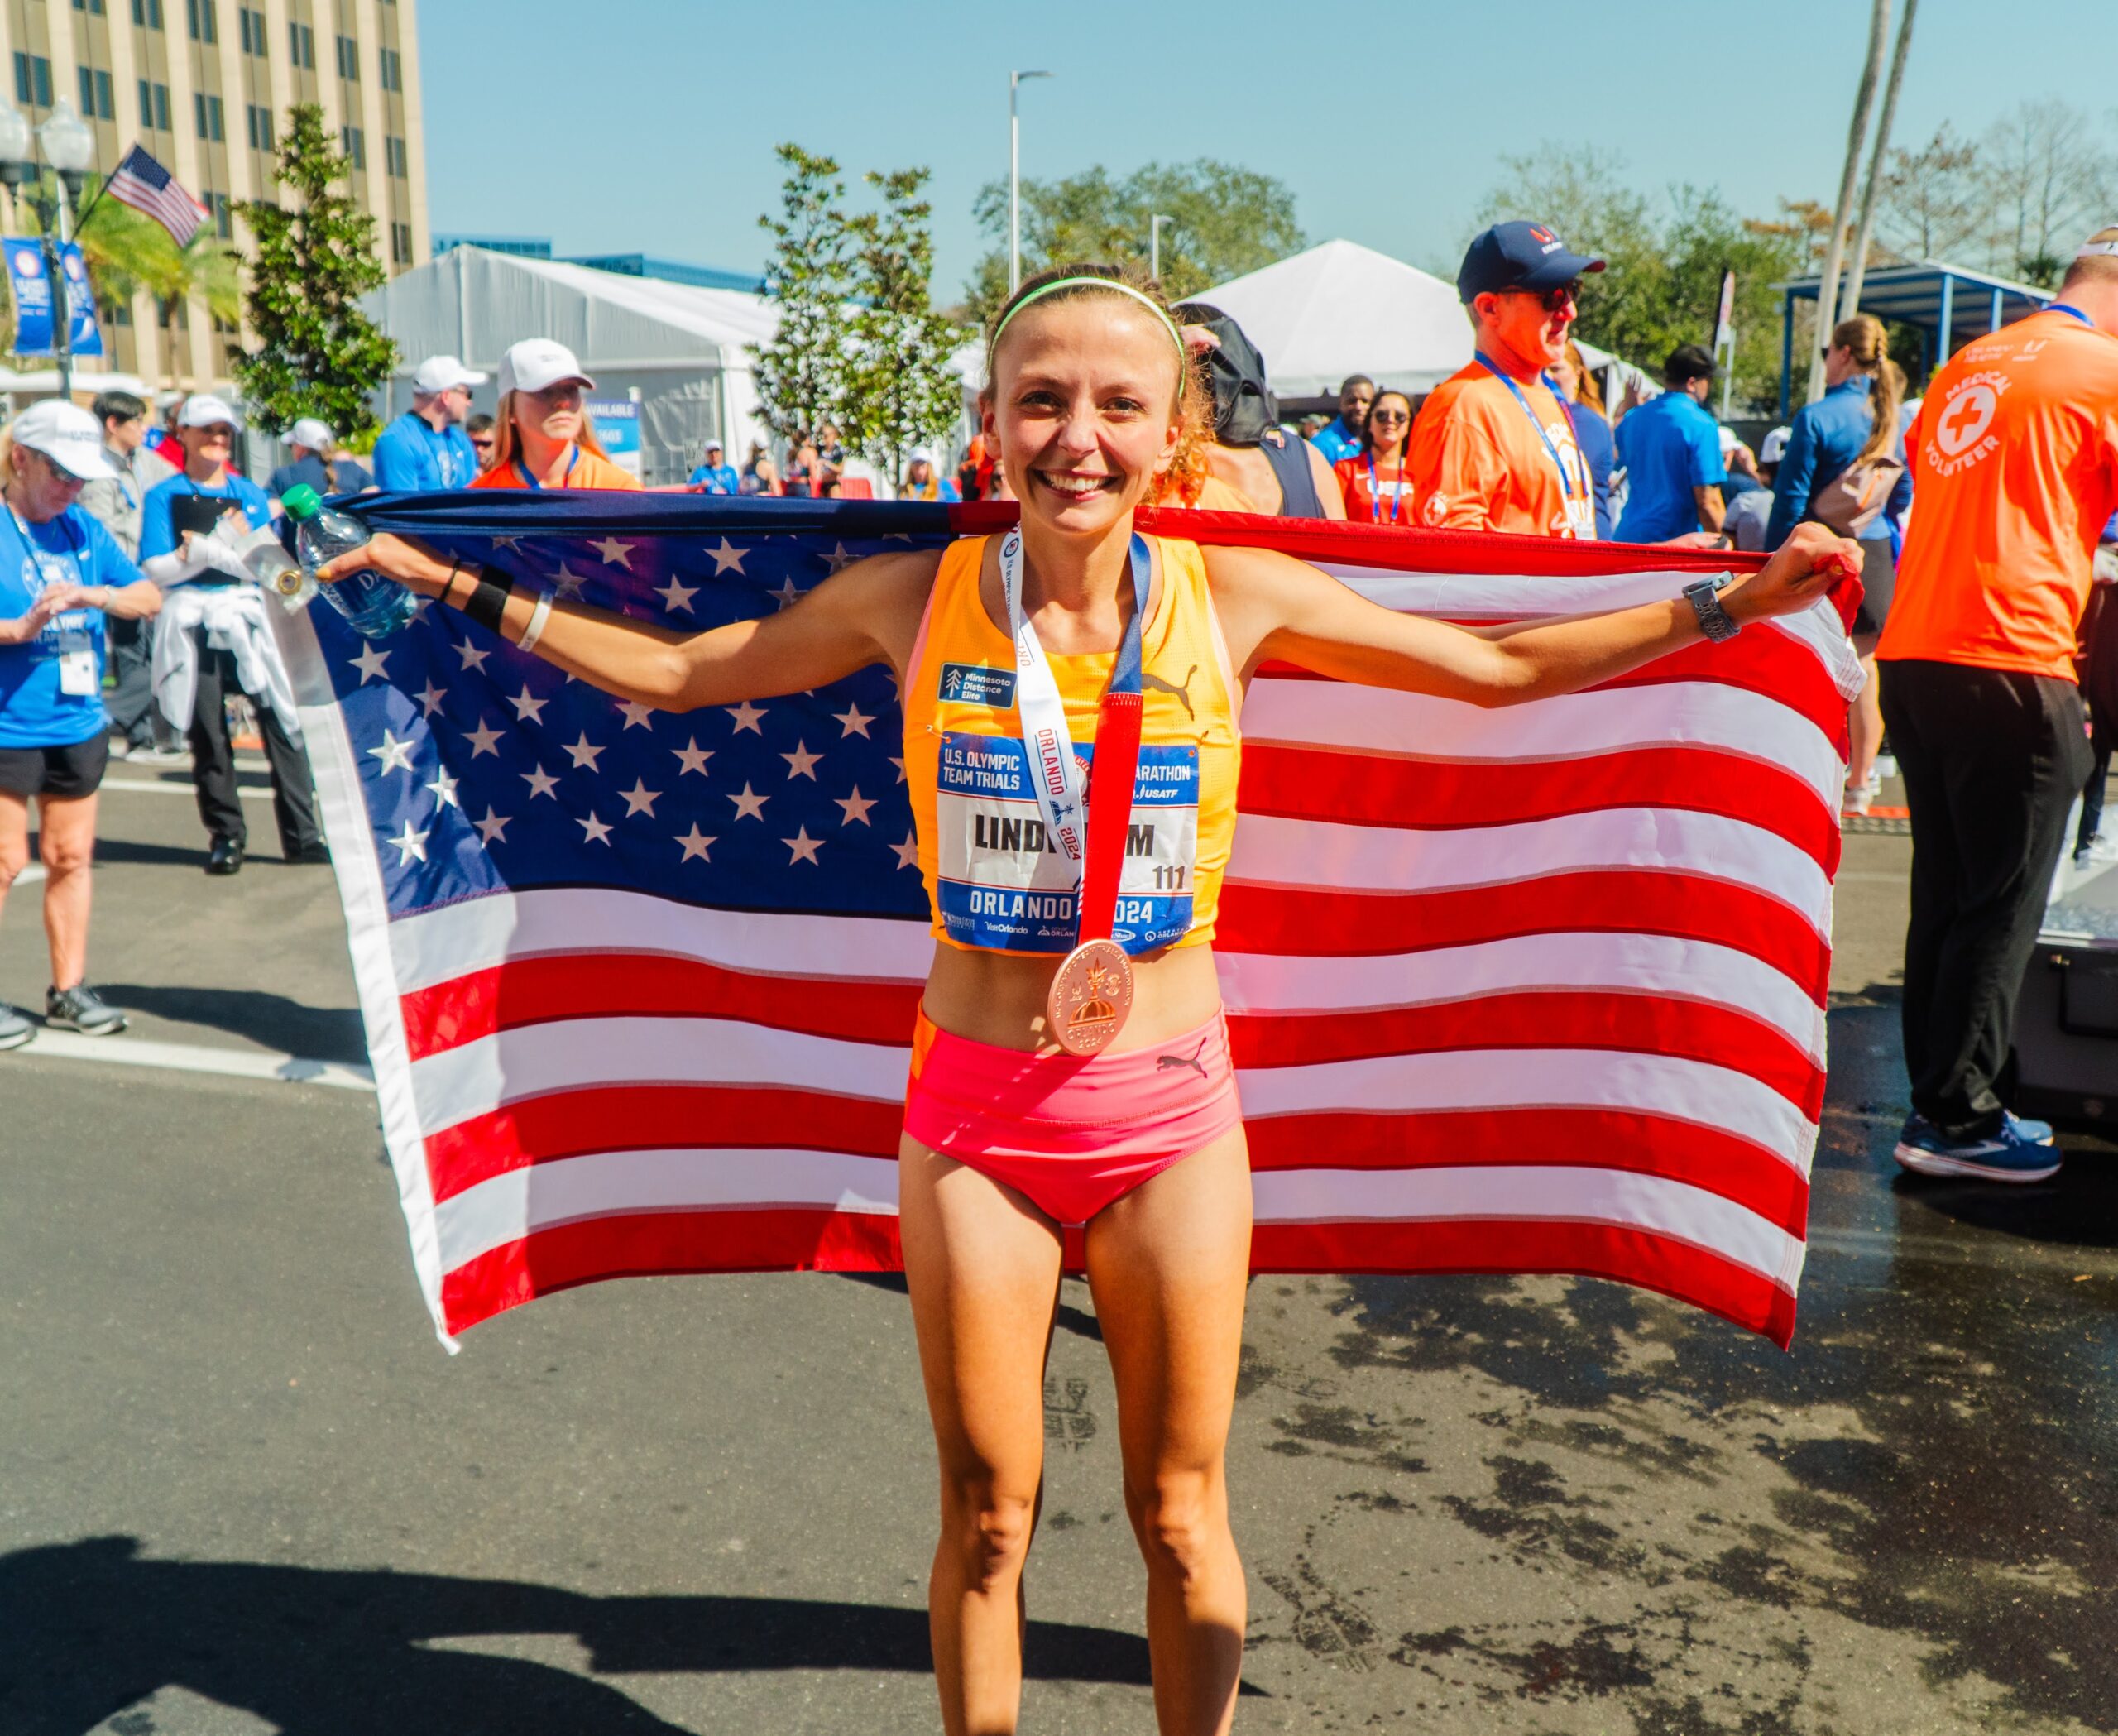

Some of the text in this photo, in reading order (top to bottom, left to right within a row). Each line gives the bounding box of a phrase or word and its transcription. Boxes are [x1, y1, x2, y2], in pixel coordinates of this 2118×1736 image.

[1946, 371, 2012, 401] MEDICAL
[963, 682, 1002, 694] Distance
[965, 673, 1011, 686] Minnesota
[961, 691, 980, 700] Elite
[944, 748, 1020, 771] U.S. OLYMPIC
[943, 766, 1020, 791] TEAM TRIALS
[1135, 765, 1191, 781] ARATHON
[1038, 728, 1081, 861] ORLANDO 2024
[1144, 789, 1179, 798] USATF
[975, 814, 1155, 857] LINDM
[1152, 865, 1186, 890] 111
[970, 890, 1072, 921] ORLANDO
[1114, 900, 1152, 924] 024
[1066, 1022, 1115, 1040] ORLANDO
[1077, 1037, 1103, 1049] 2024
